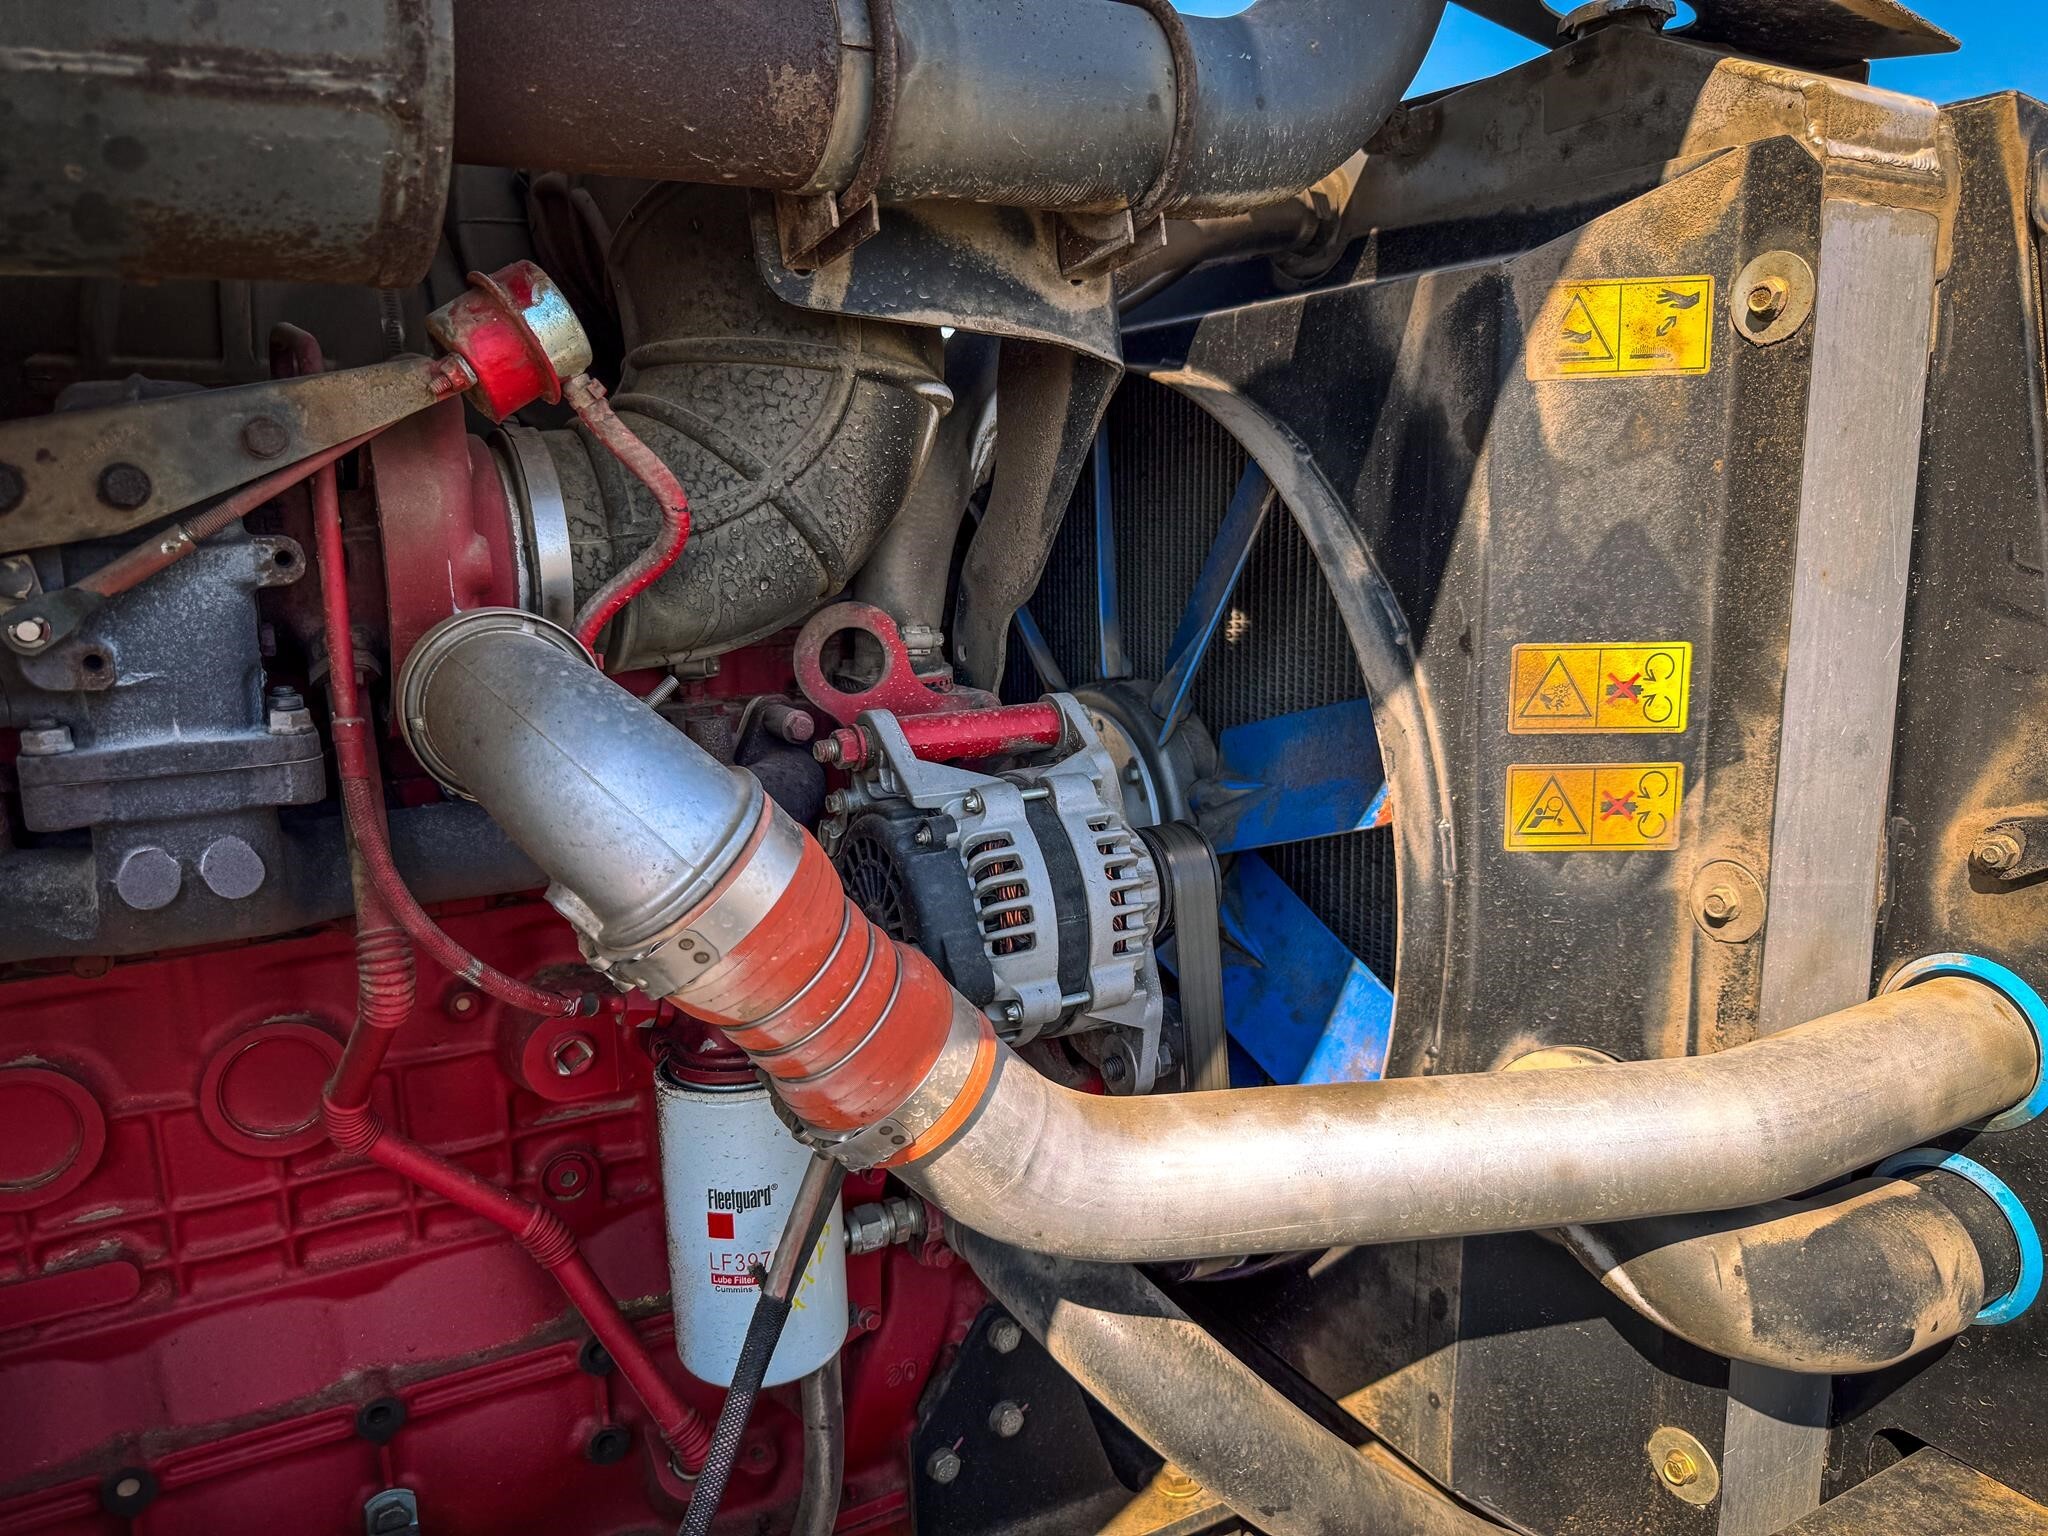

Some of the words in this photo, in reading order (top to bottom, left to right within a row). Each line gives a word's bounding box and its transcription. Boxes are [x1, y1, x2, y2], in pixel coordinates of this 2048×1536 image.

[712, 1274, 732, 1284] Lube
[733, 1275, 756, 1285] Filter
[715, 1285, 753, 1293] Cummins
